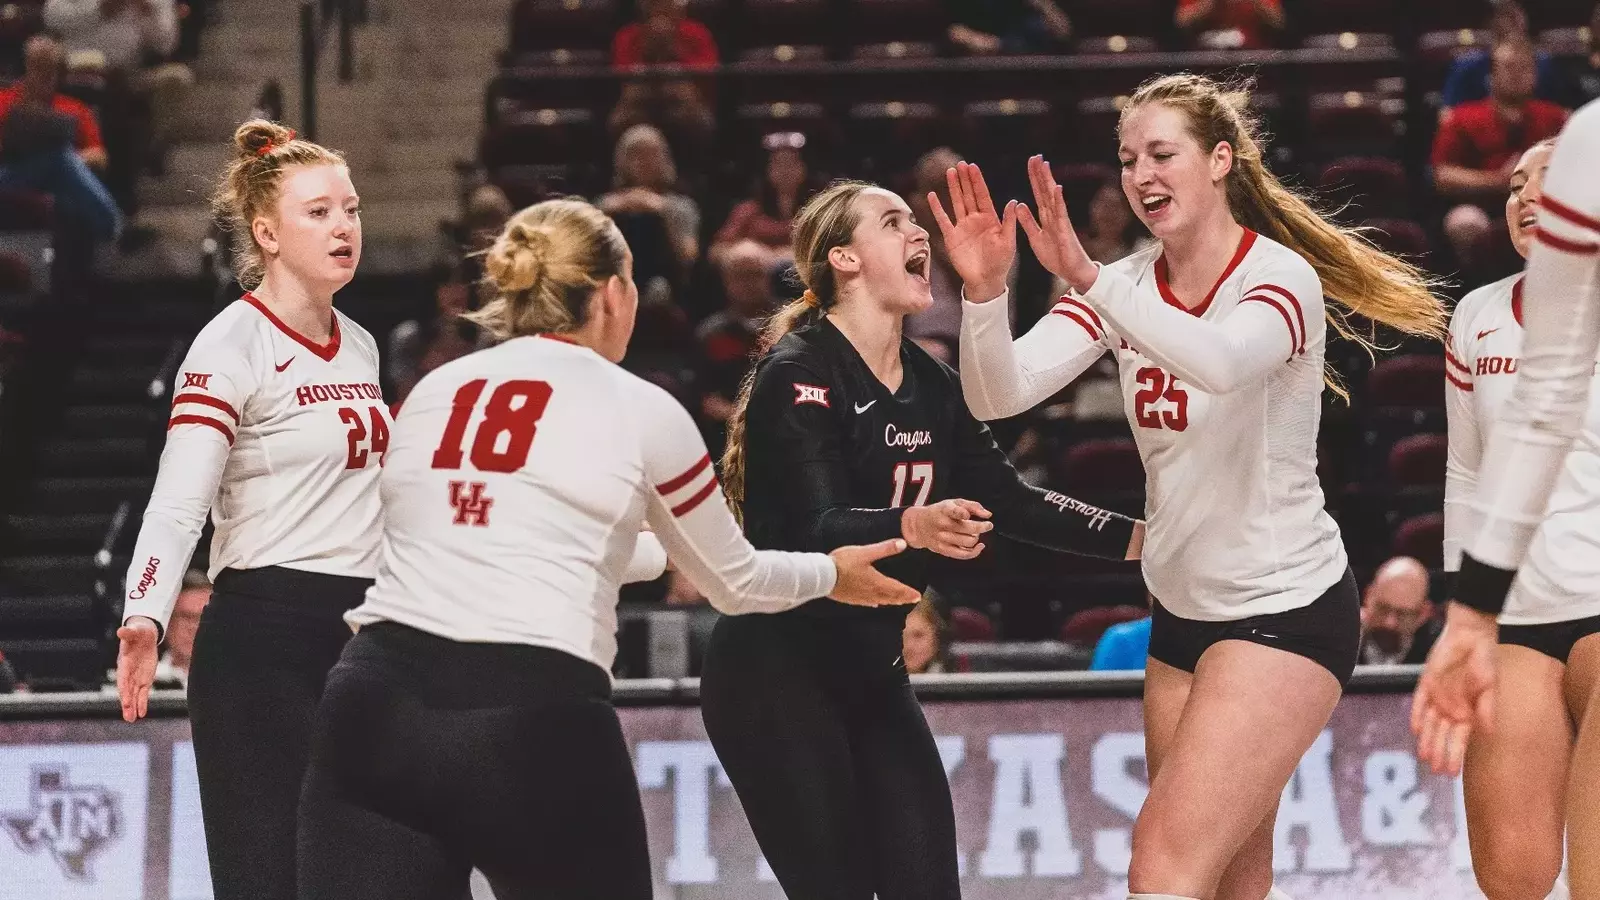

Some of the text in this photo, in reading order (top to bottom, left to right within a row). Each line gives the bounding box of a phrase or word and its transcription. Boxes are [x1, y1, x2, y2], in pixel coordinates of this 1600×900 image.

[1135, 366, 1189, 432] 25
[337, 406, 390, 470] 24
[431, 378, 554, 474] 18
[884, 423, 932, 453] Cougars
[448, 480, 495, 528] UH
[890, 461, 935, 509] 17
[1044, 490, 1112, 532] Houston
[129, 556, 161, 600] Cougars
[636, 731, 1149, 884] TAS
